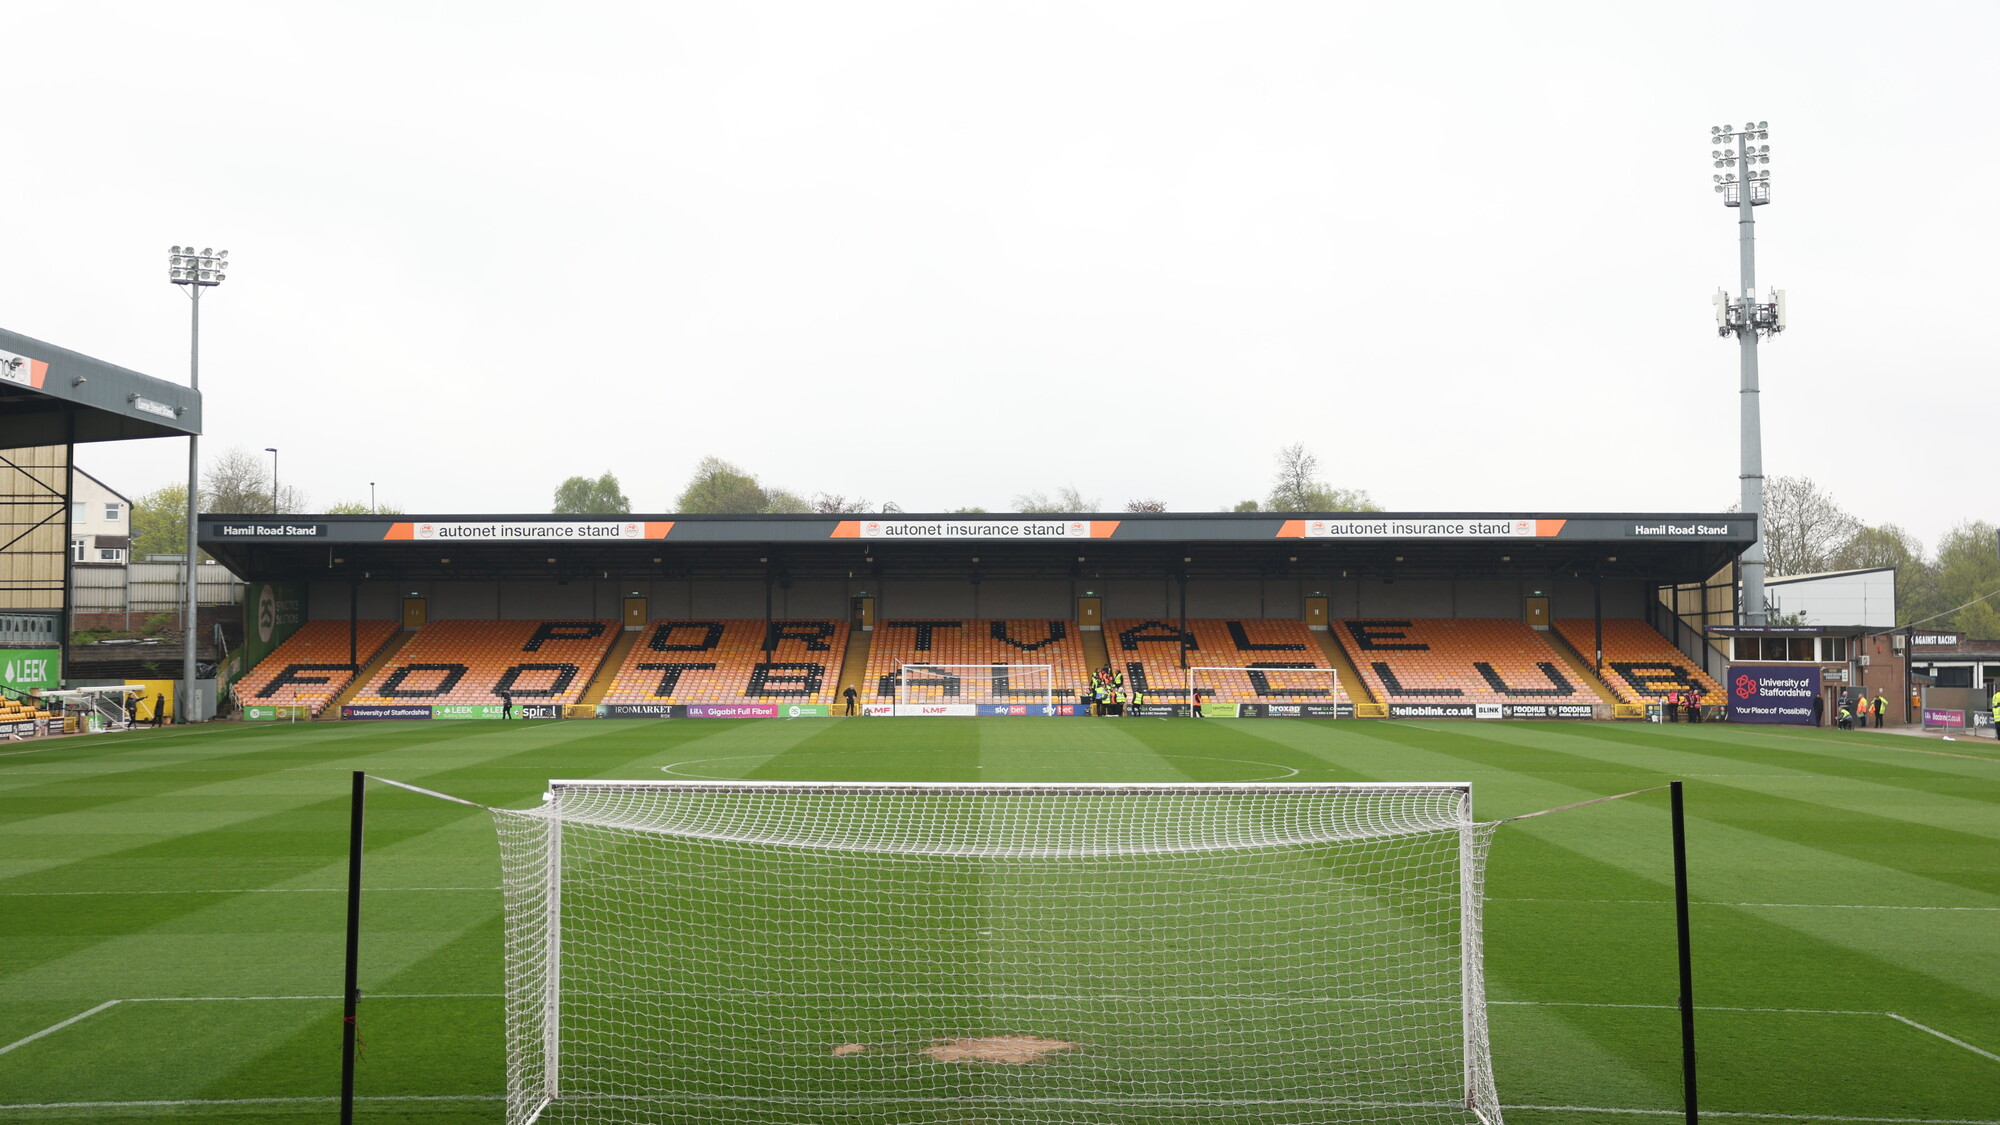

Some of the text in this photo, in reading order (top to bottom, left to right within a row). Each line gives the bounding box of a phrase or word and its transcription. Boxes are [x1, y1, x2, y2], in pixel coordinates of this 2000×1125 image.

[223, 526, 316, 536] Hamil Road Stand
[439, 524, 620, 537] autonet insurance stand
[886, 524, 1065, 536] autonet insurance stand
[1331, 522, 1510, 534] autonet insurance stand
[1635, 525, 1728, 535] Hamil Road Stand
[1915, 636, 1936, 644] AGAINST
[1938, 636, 1956, 644] RACISM
[17, 660, 47, 682] LEEK
[1759, 678, 1809, 688] University of
[1760, 688, 1811, 697] Staffordshire
[708, 708, 736, 716] Gigabit
[995, 706, 1009, 715] sky
[1779, 708, 1812, 716] Possibility
